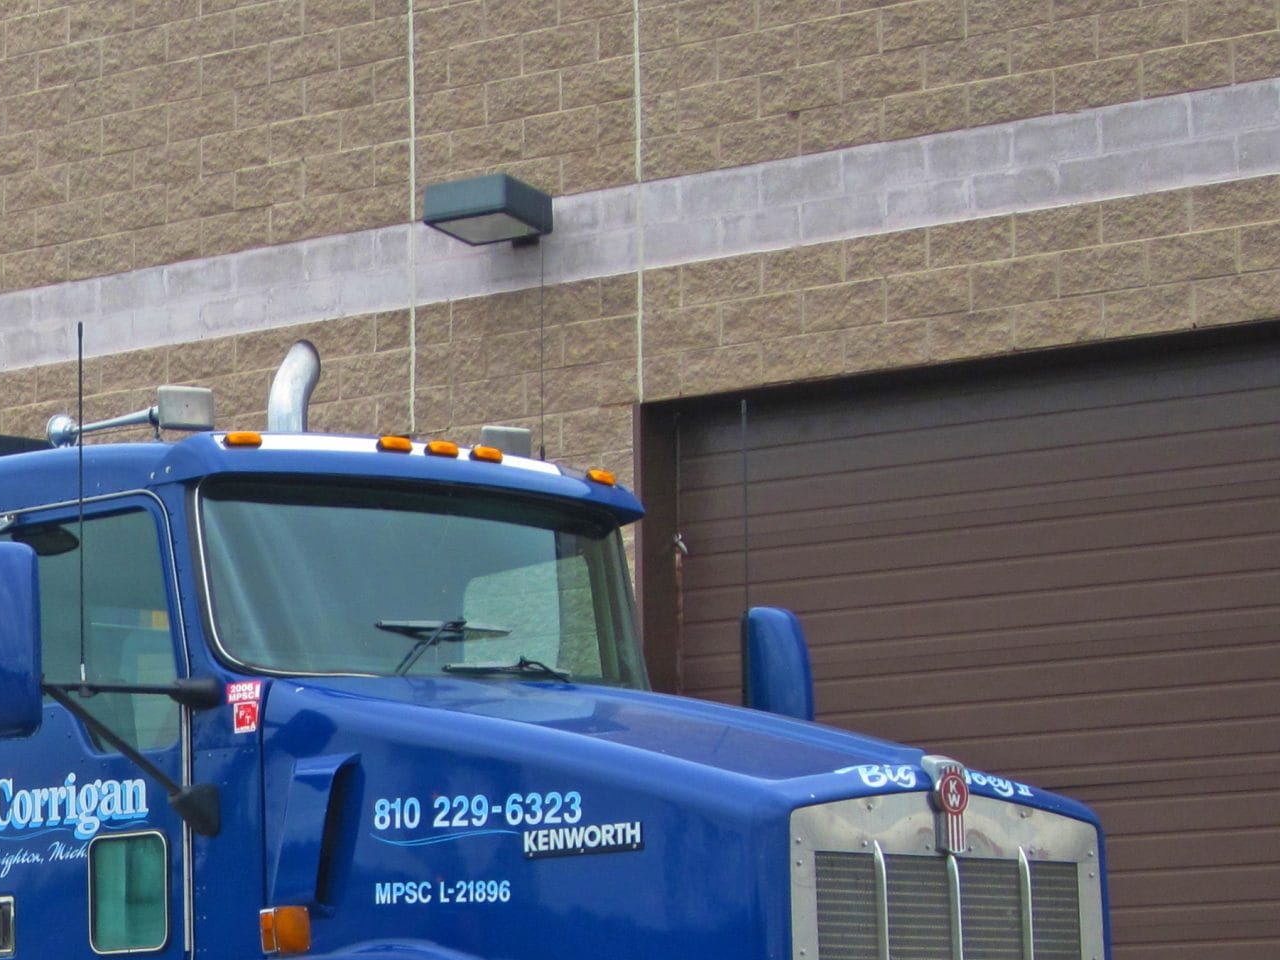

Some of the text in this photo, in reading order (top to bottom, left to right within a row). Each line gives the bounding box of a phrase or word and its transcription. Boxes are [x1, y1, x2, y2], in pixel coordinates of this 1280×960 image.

[834, 764, 917, 788] Big
[374, 791, 582, 830] 810 229-6323
[523, 821, 641, 853] KENWORTH
[375, 880, 511, 905] MPSC L-21896
